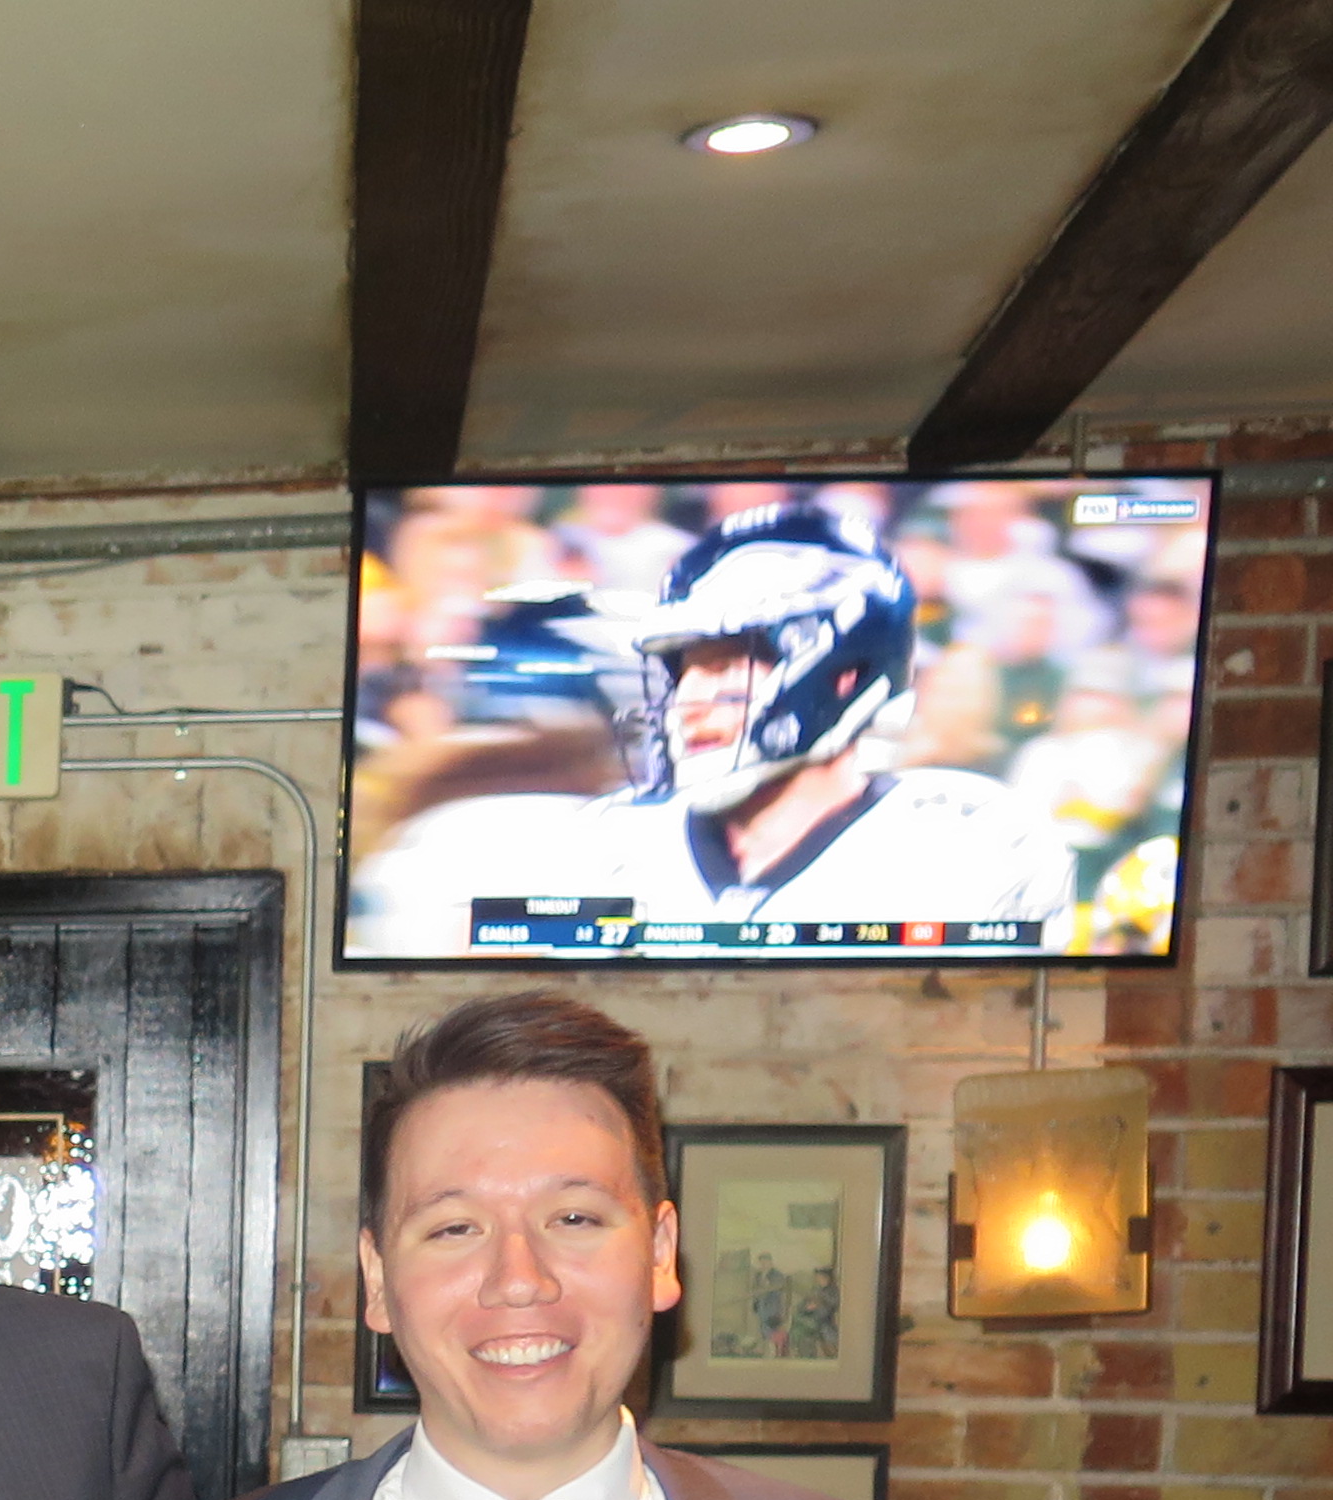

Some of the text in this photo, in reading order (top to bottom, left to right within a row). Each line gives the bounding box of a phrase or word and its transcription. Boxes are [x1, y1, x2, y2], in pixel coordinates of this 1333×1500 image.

[525, 898, 581, 915] TIMEOUT
[478, 924, 530, 942] EAGLES
[599, 923, 630, 946] 27
[765, 922, 796, 945] 20
